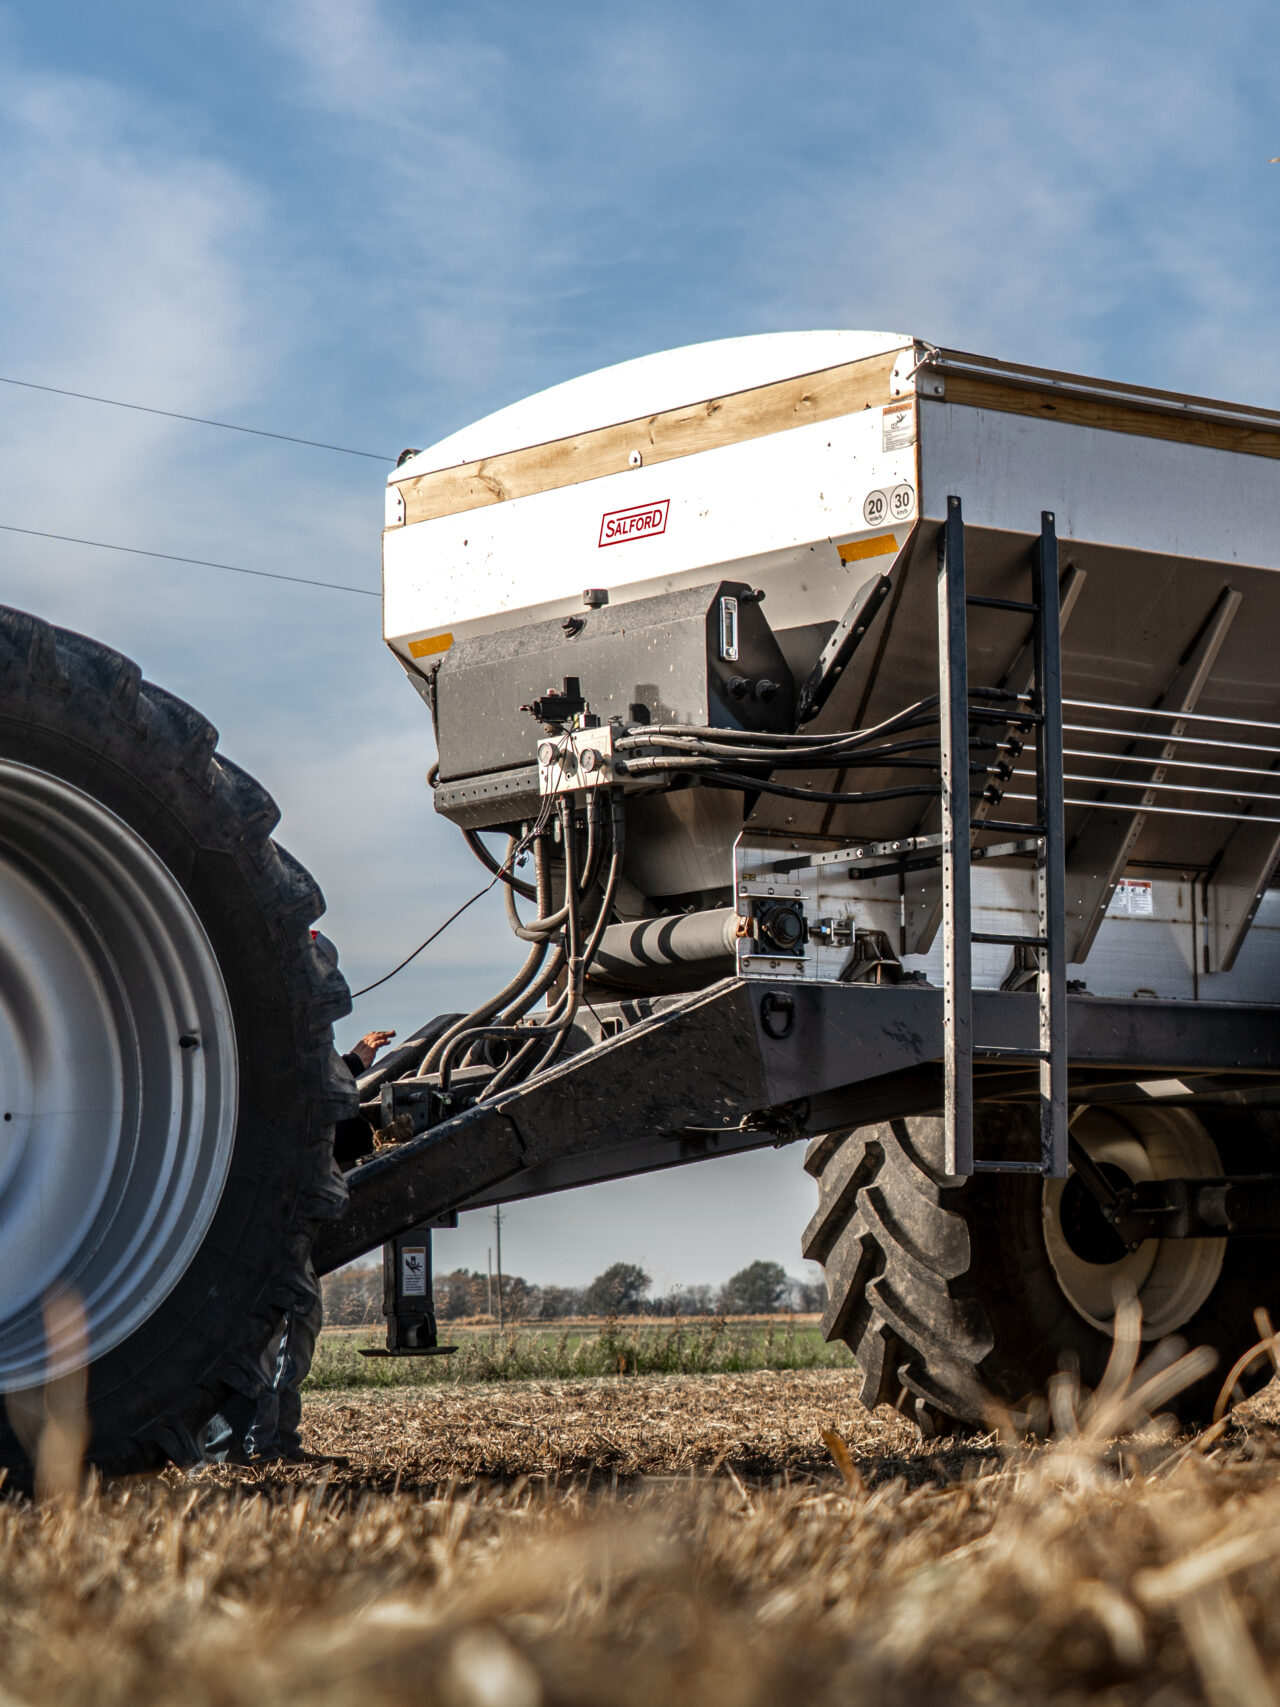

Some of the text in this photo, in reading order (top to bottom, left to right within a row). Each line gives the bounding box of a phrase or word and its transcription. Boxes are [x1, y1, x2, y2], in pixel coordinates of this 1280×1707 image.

[868, 498, 883, 515] 20
[895, 491, 910, 509] 30
[605, 509, 663, 538] SALFORD
